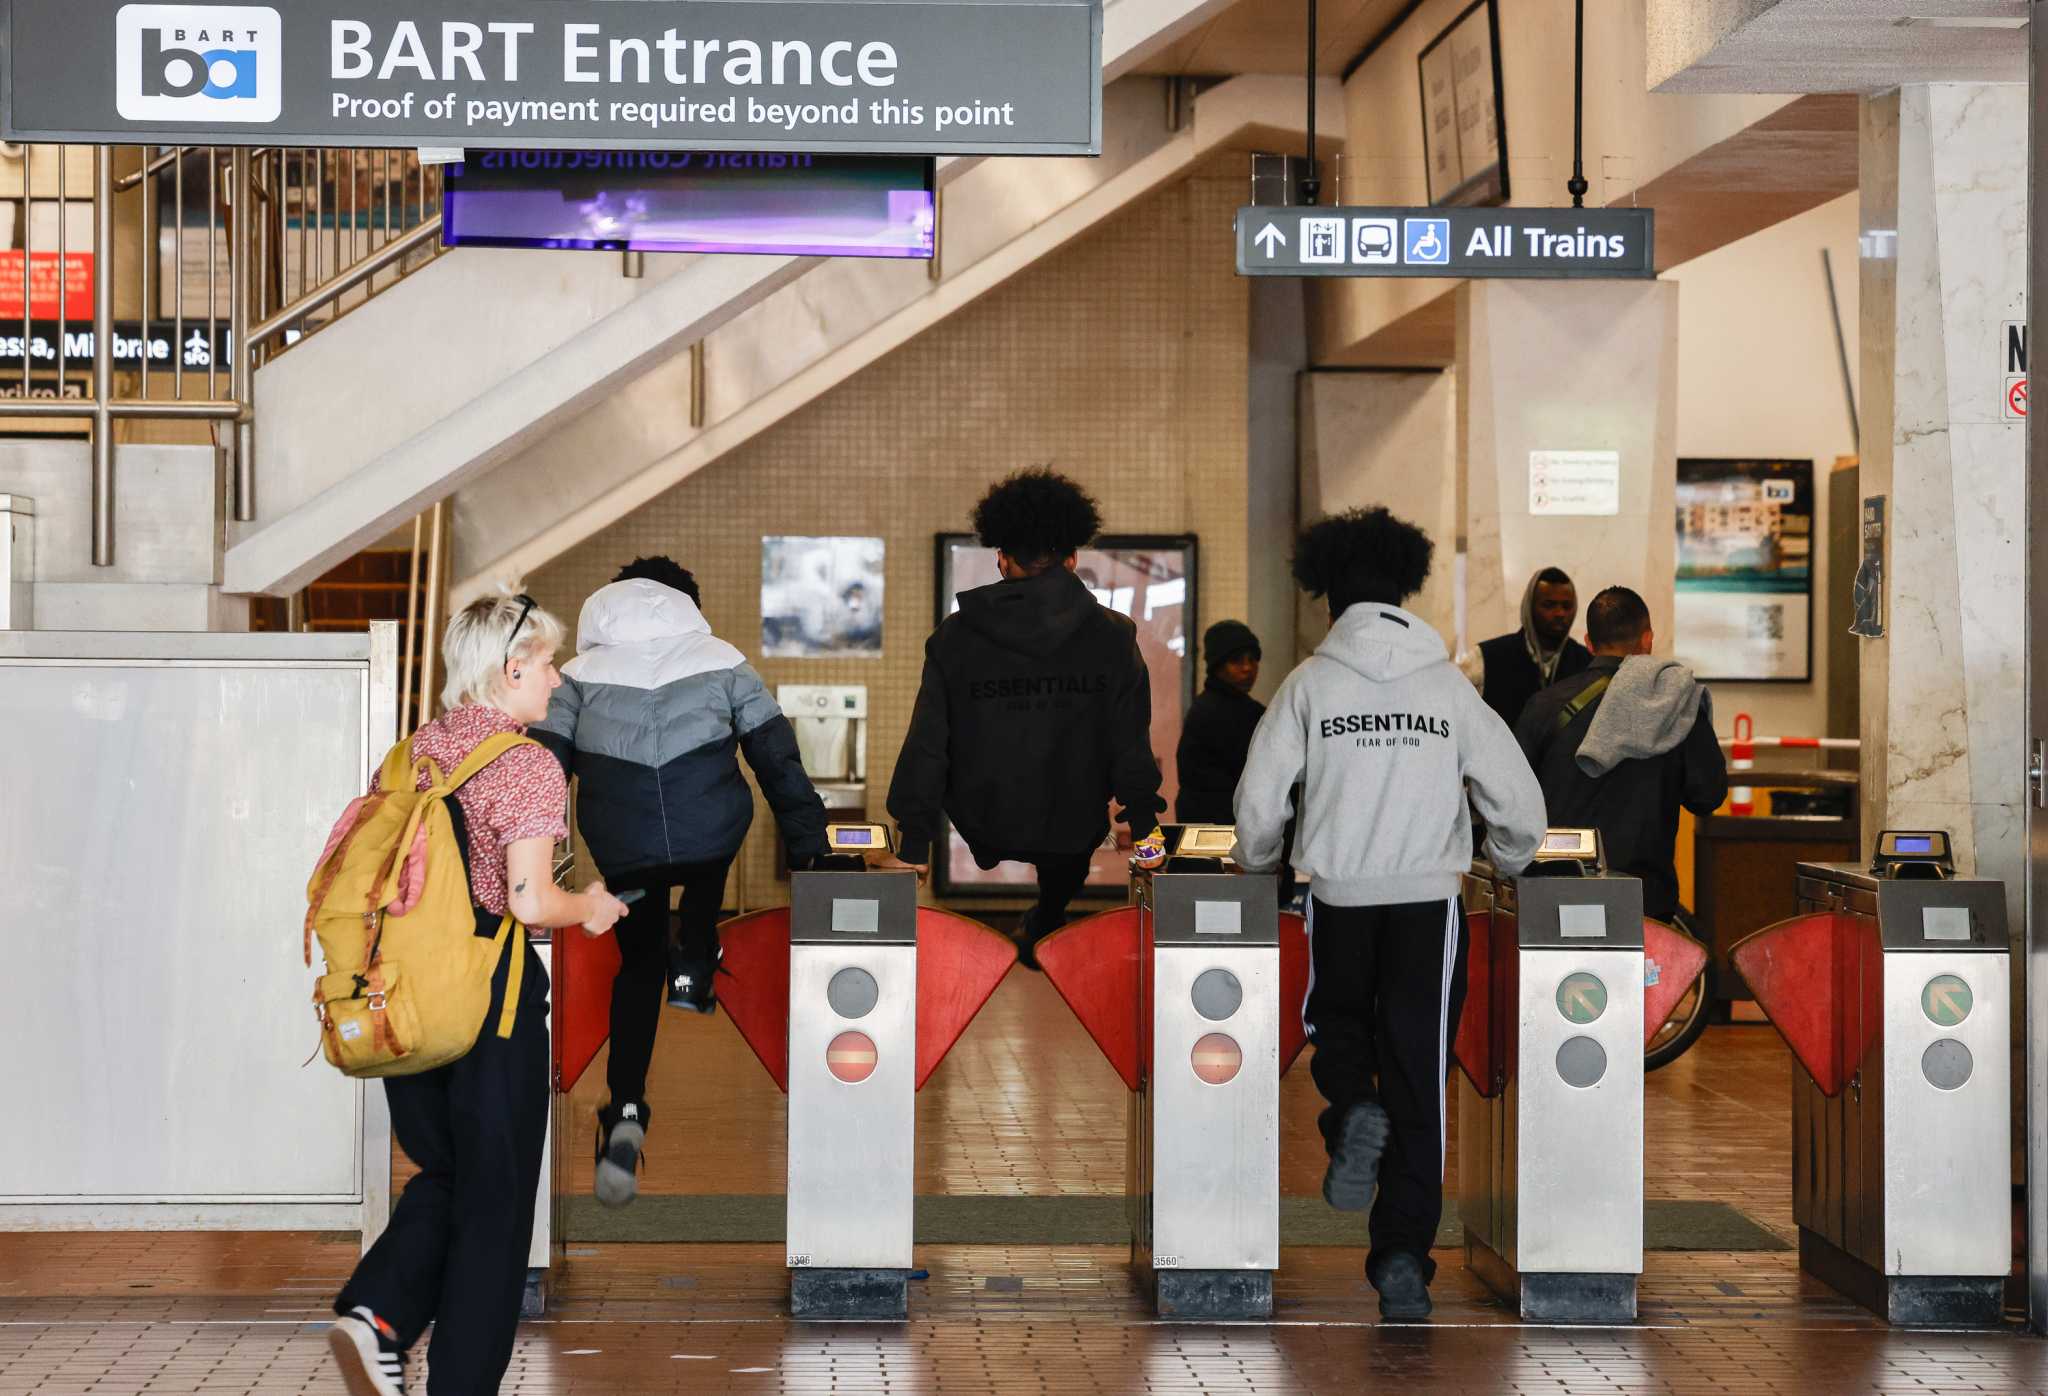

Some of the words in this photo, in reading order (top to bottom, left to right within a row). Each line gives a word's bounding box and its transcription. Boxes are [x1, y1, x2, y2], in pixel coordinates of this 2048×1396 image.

[174, 29, 258, 43] BART
[331, 20, 535, 81] BART
[563, 23, 898, 87] Entrance
[332, 92, 415, 119] Proof
[423, 93, 457, 119] of
[466, 97, 600, 127] payment
[609, 96, 736, 128] required
[747, 97, 859, 131] beyond
[868, 98, 924, 125] this
[935, 100, 1015, 131] point
[1465, 225, 1512, 257] All
[1523, 226, 1625, 258] Trains
[64, 332, 169, 358] Mibrae
[968, 674, 1108, 699] ESSENTIALS
[1320, 713, 1450, 738] ESSENTIALS
[1356, 738, 1381, 748] FEAR
[1386, 737, 1397, 747] OF
[1402, 736, 1420, 747] GOD
[1155, 1256, 1177, 1266] 3560
